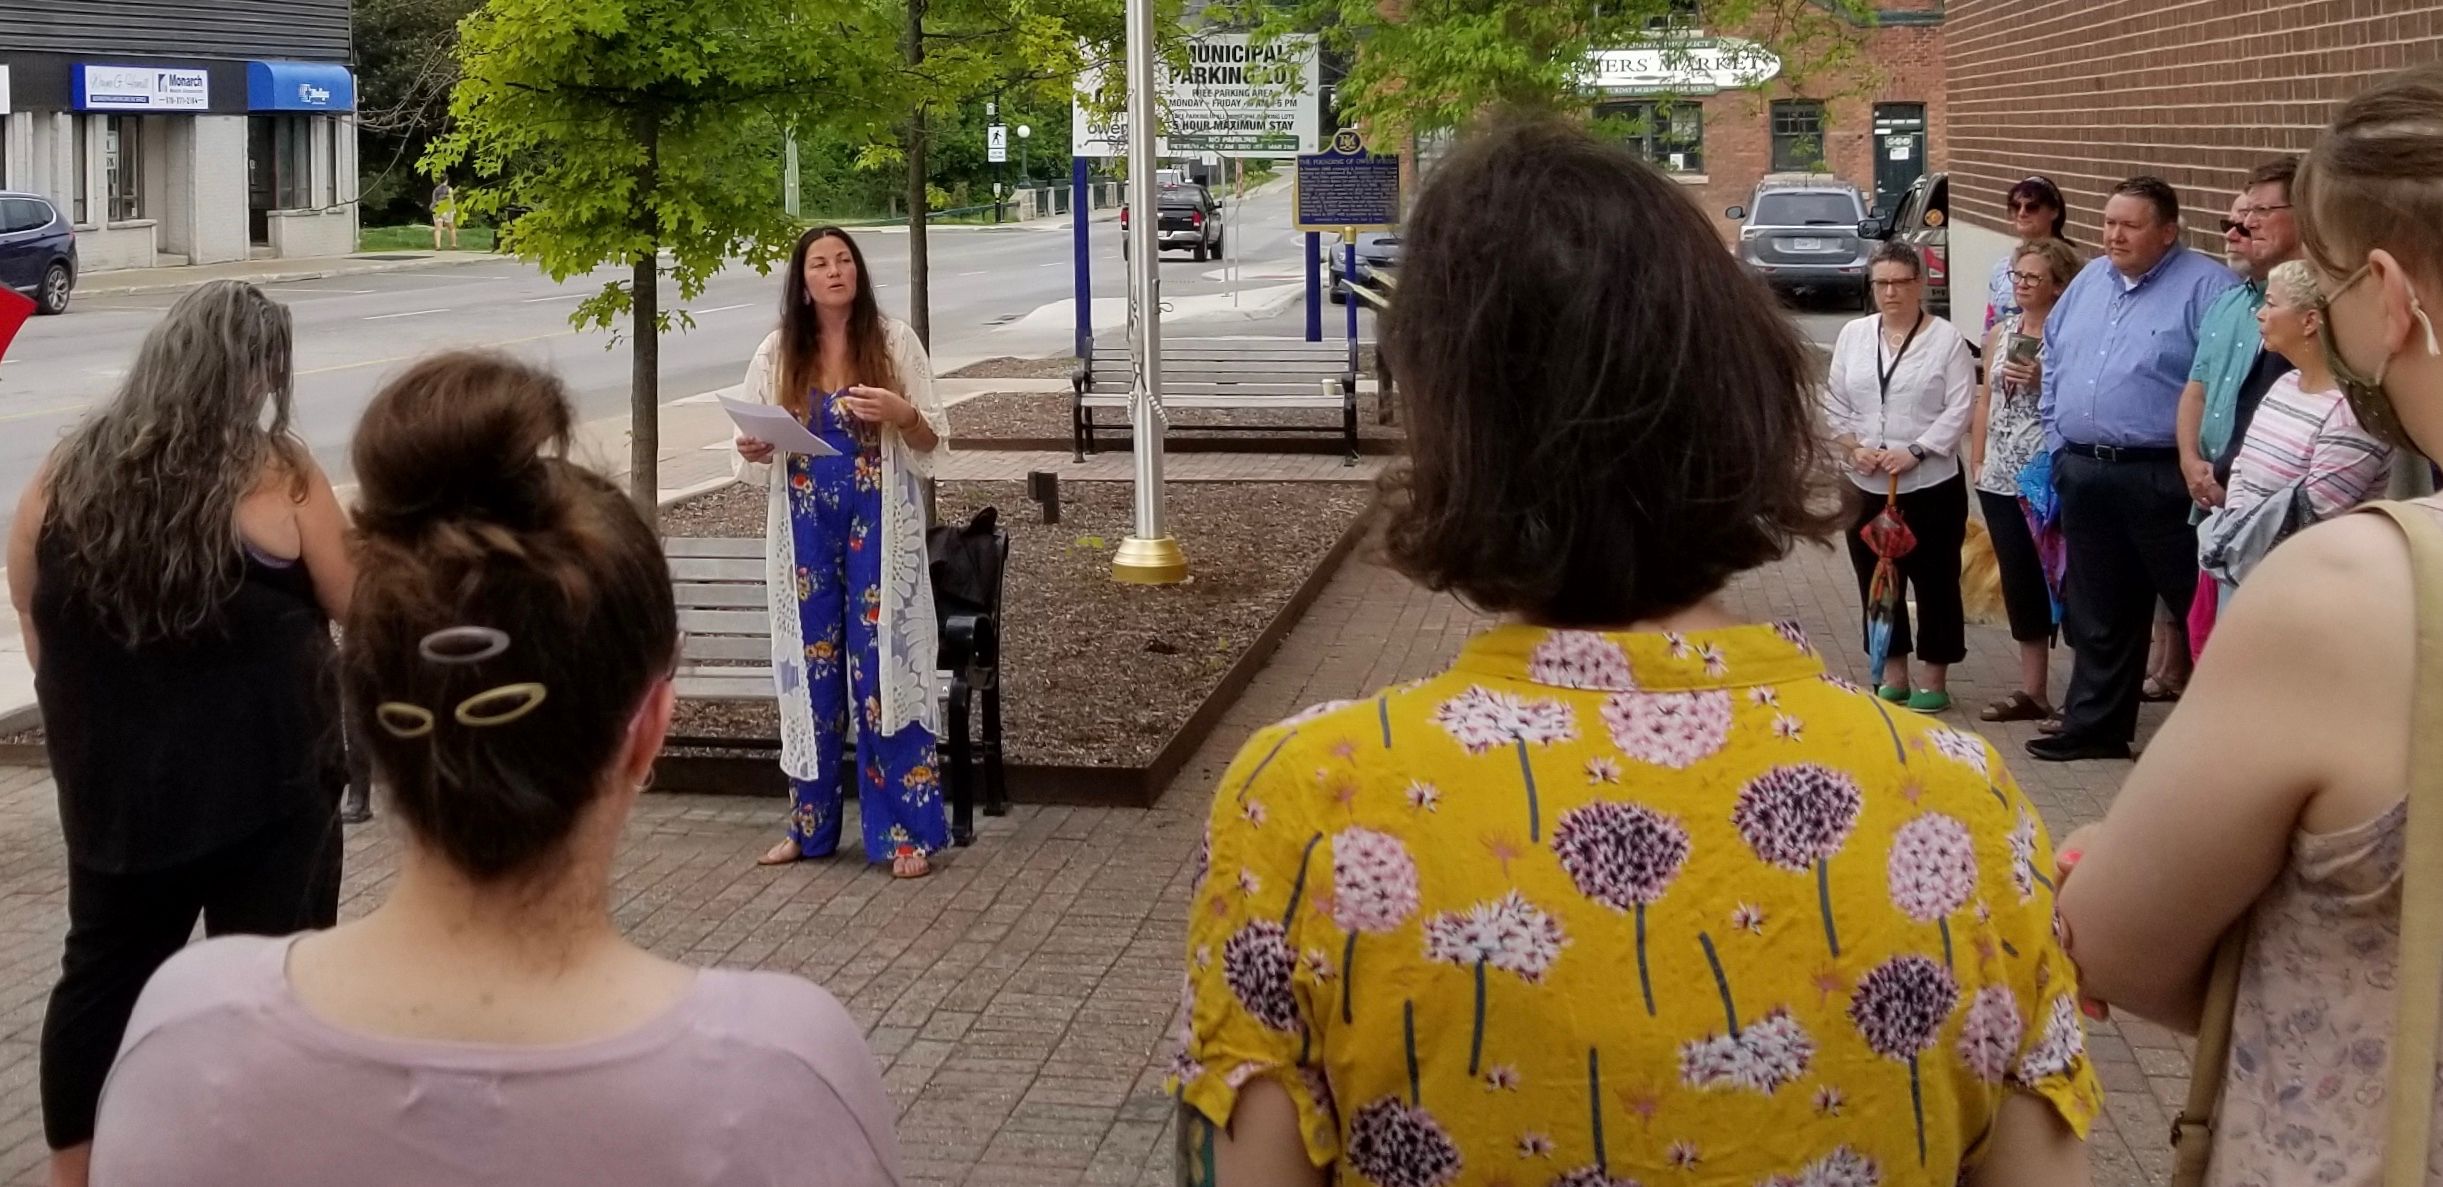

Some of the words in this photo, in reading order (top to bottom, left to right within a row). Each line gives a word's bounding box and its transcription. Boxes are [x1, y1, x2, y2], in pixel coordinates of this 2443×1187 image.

[169, 74, 202, 87] Monarch
[1214, 89, 1250, 98] PARKING
[1252, 89, 1274, 97] AREA
[1168, 99, 1204, 107] MONDAY
[1212, 99, 1242, 107] FRIDAY
[1284, 99, 1298, 107] PM
[1182, 121, 1211, 130] HOUR
[1213, 121, 1265, 130] MAXIMUM
[1269, 121, 1294, 130] STAY
